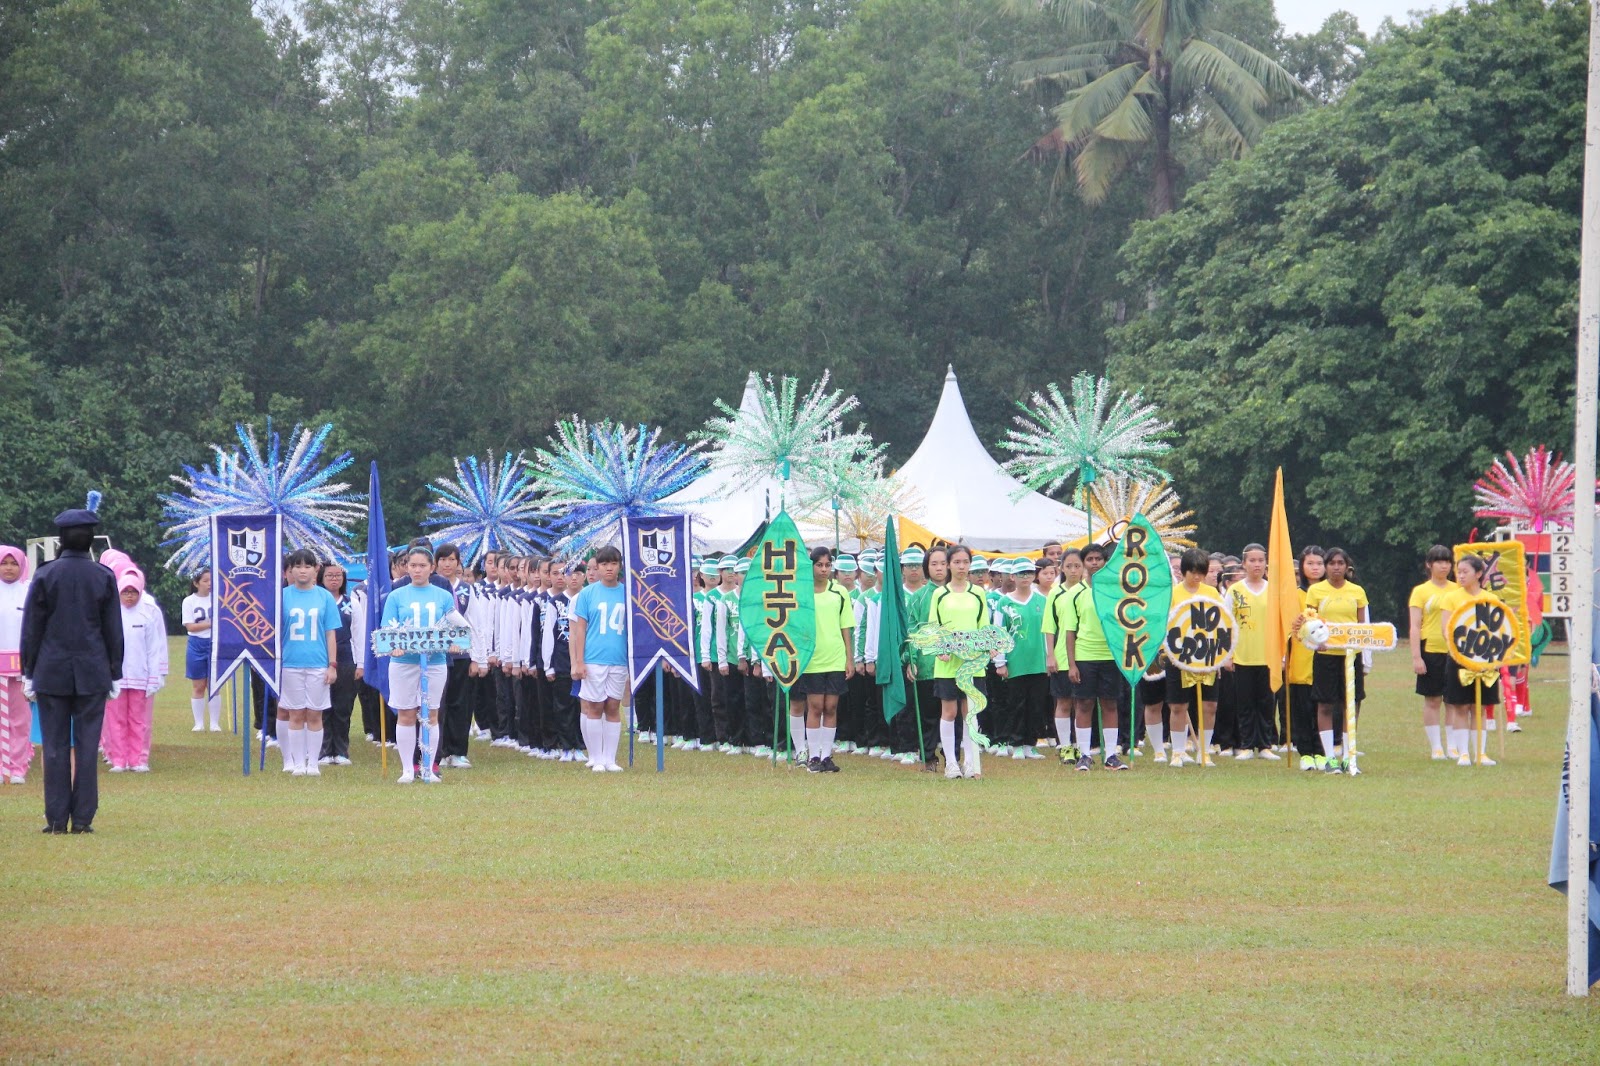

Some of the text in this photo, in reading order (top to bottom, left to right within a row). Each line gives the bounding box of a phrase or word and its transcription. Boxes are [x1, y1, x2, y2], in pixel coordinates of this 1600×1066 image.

[1557, 536, 1569, 551] 2
[1559, 557, 1567, 571] 3
[1117, 528, 1149, 668] ROCK
[1559, 577, 1567, 591] 3
[410, 602, 436, 628] 11
[597, 602, 625, 635] 14
[764, 541, 797, 684] HIJAU
[1190, 602, 1221, 632] NO
[1475, 602, 1504, 632] NO
[1557, 595, 1570, 612] 3
[290, 608, 318, 641] 21
[380, 630, 434, 641] STRIVE
[1330, 627, 1373, 635] No Crown
[1167, 627, 1232, 666] CROWN
[1453, 625, 1515, 663] GLORY
